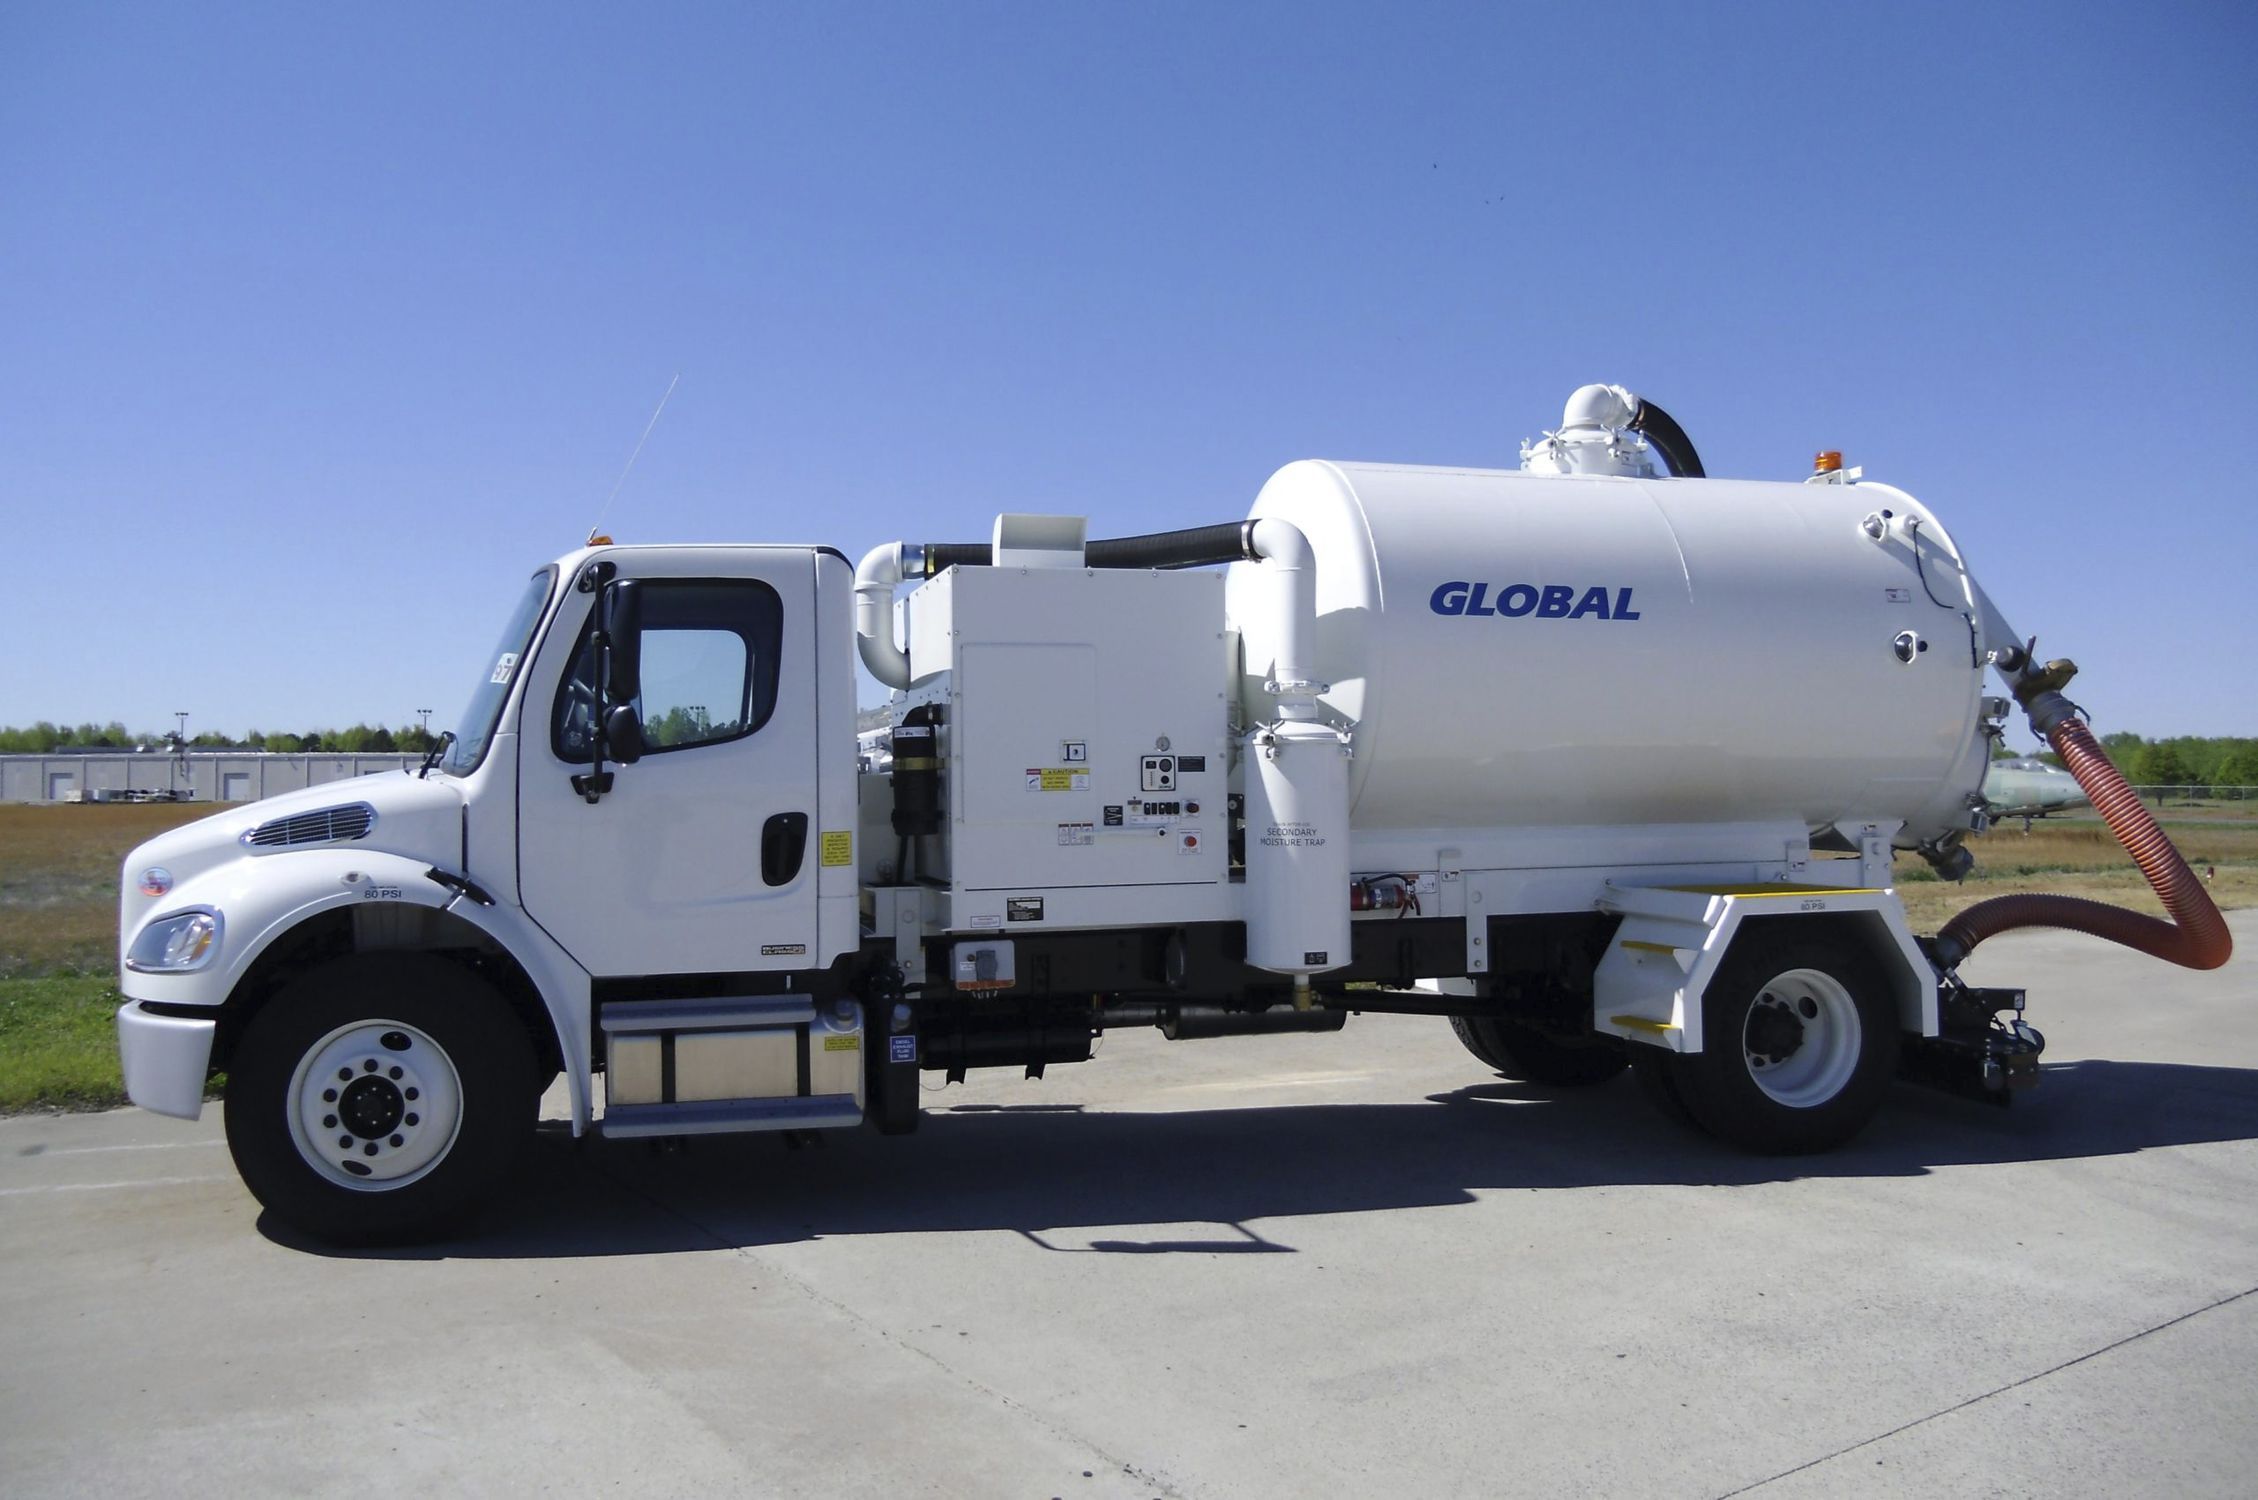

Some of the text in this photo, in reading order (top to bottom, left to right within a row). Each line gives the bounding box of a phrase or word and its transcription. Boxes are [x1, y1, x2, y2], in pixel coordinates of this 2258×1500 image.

[1430, 581, 1640, 621] GLOBAL
[1267, 827, 1317, 836] SECONDARY
[1260, 838, 1326, 847] MOISTURE TRAP
[364, 889, 402, 899] 80 PSI
[1812, 902, 1825, 911] PSI
